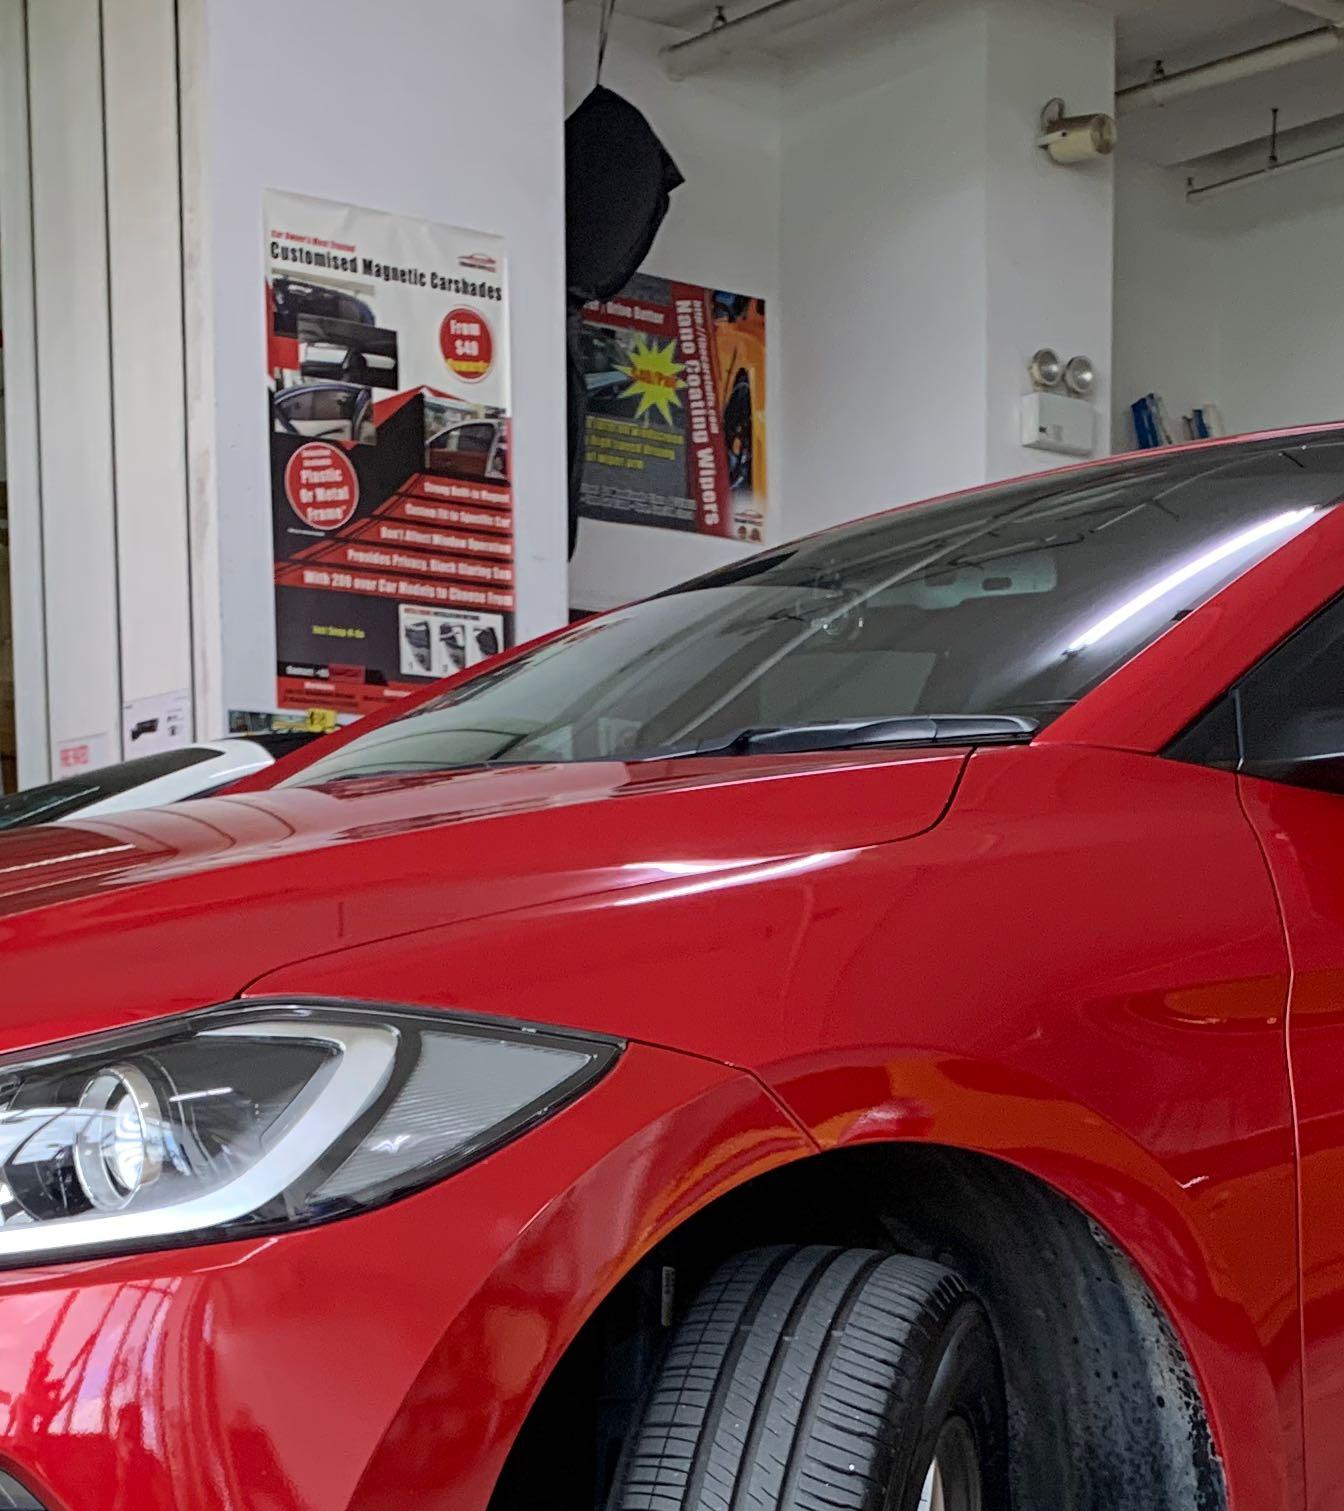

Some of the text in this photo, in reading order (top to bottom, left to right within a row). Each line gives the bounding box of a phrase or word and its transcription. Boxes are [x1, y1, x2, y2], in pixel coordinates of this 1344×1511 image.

[271, 241, 357, 273] Customised
[362, 257, 426, 288] Magnetic
[431, 271, 503, 301] Carshades
[675, 299, 721, 526] Nano Coating Wipers
[303, 569, 331, 586] With
[377, 578, 398, 594] Car
